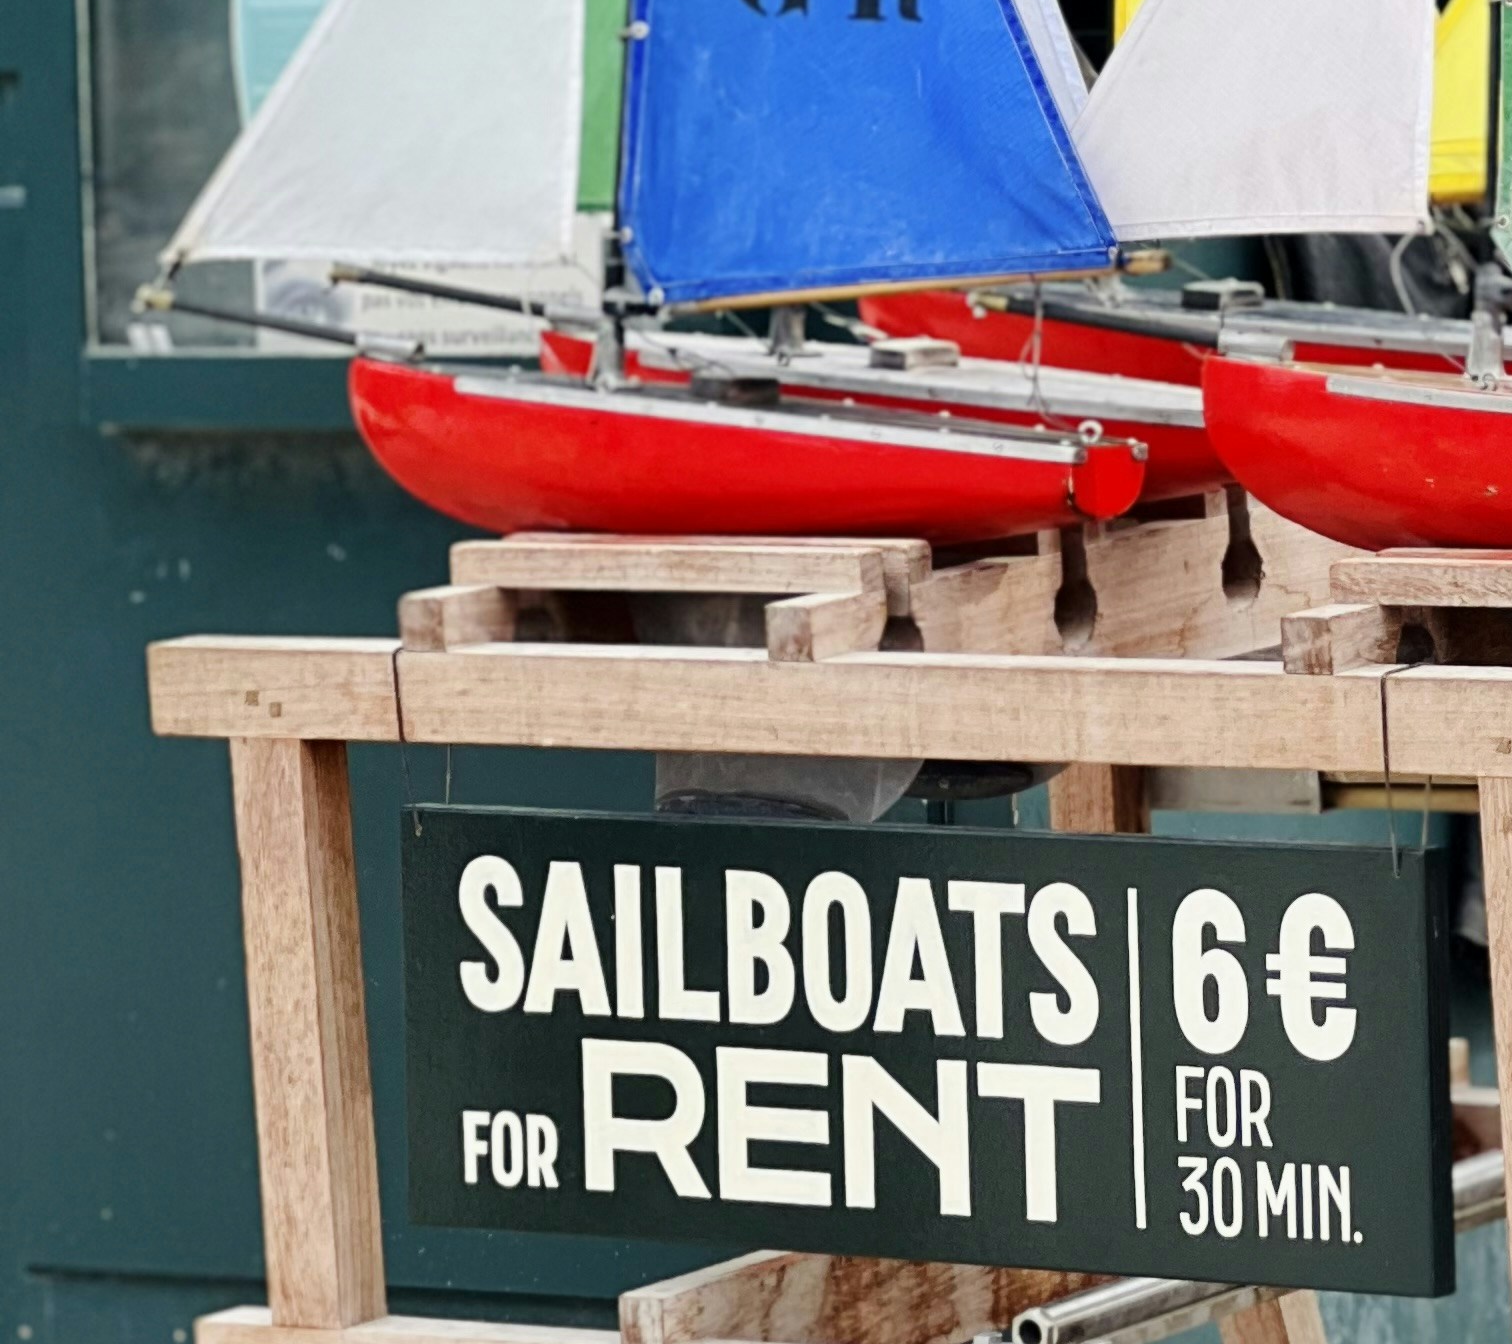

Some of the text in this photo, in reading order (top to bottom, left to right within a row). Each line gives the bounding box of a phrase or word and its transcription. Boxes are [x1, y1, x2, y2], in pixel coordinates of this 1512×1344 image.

[458, 855, 1100, 1046] SAILBOATS
[462, 1037, 1101, 1223] FOR RENT
[1175, 1065, 1274, 1149] FOR
[1177, 1156, 1364, 1243] 30 MIN.
